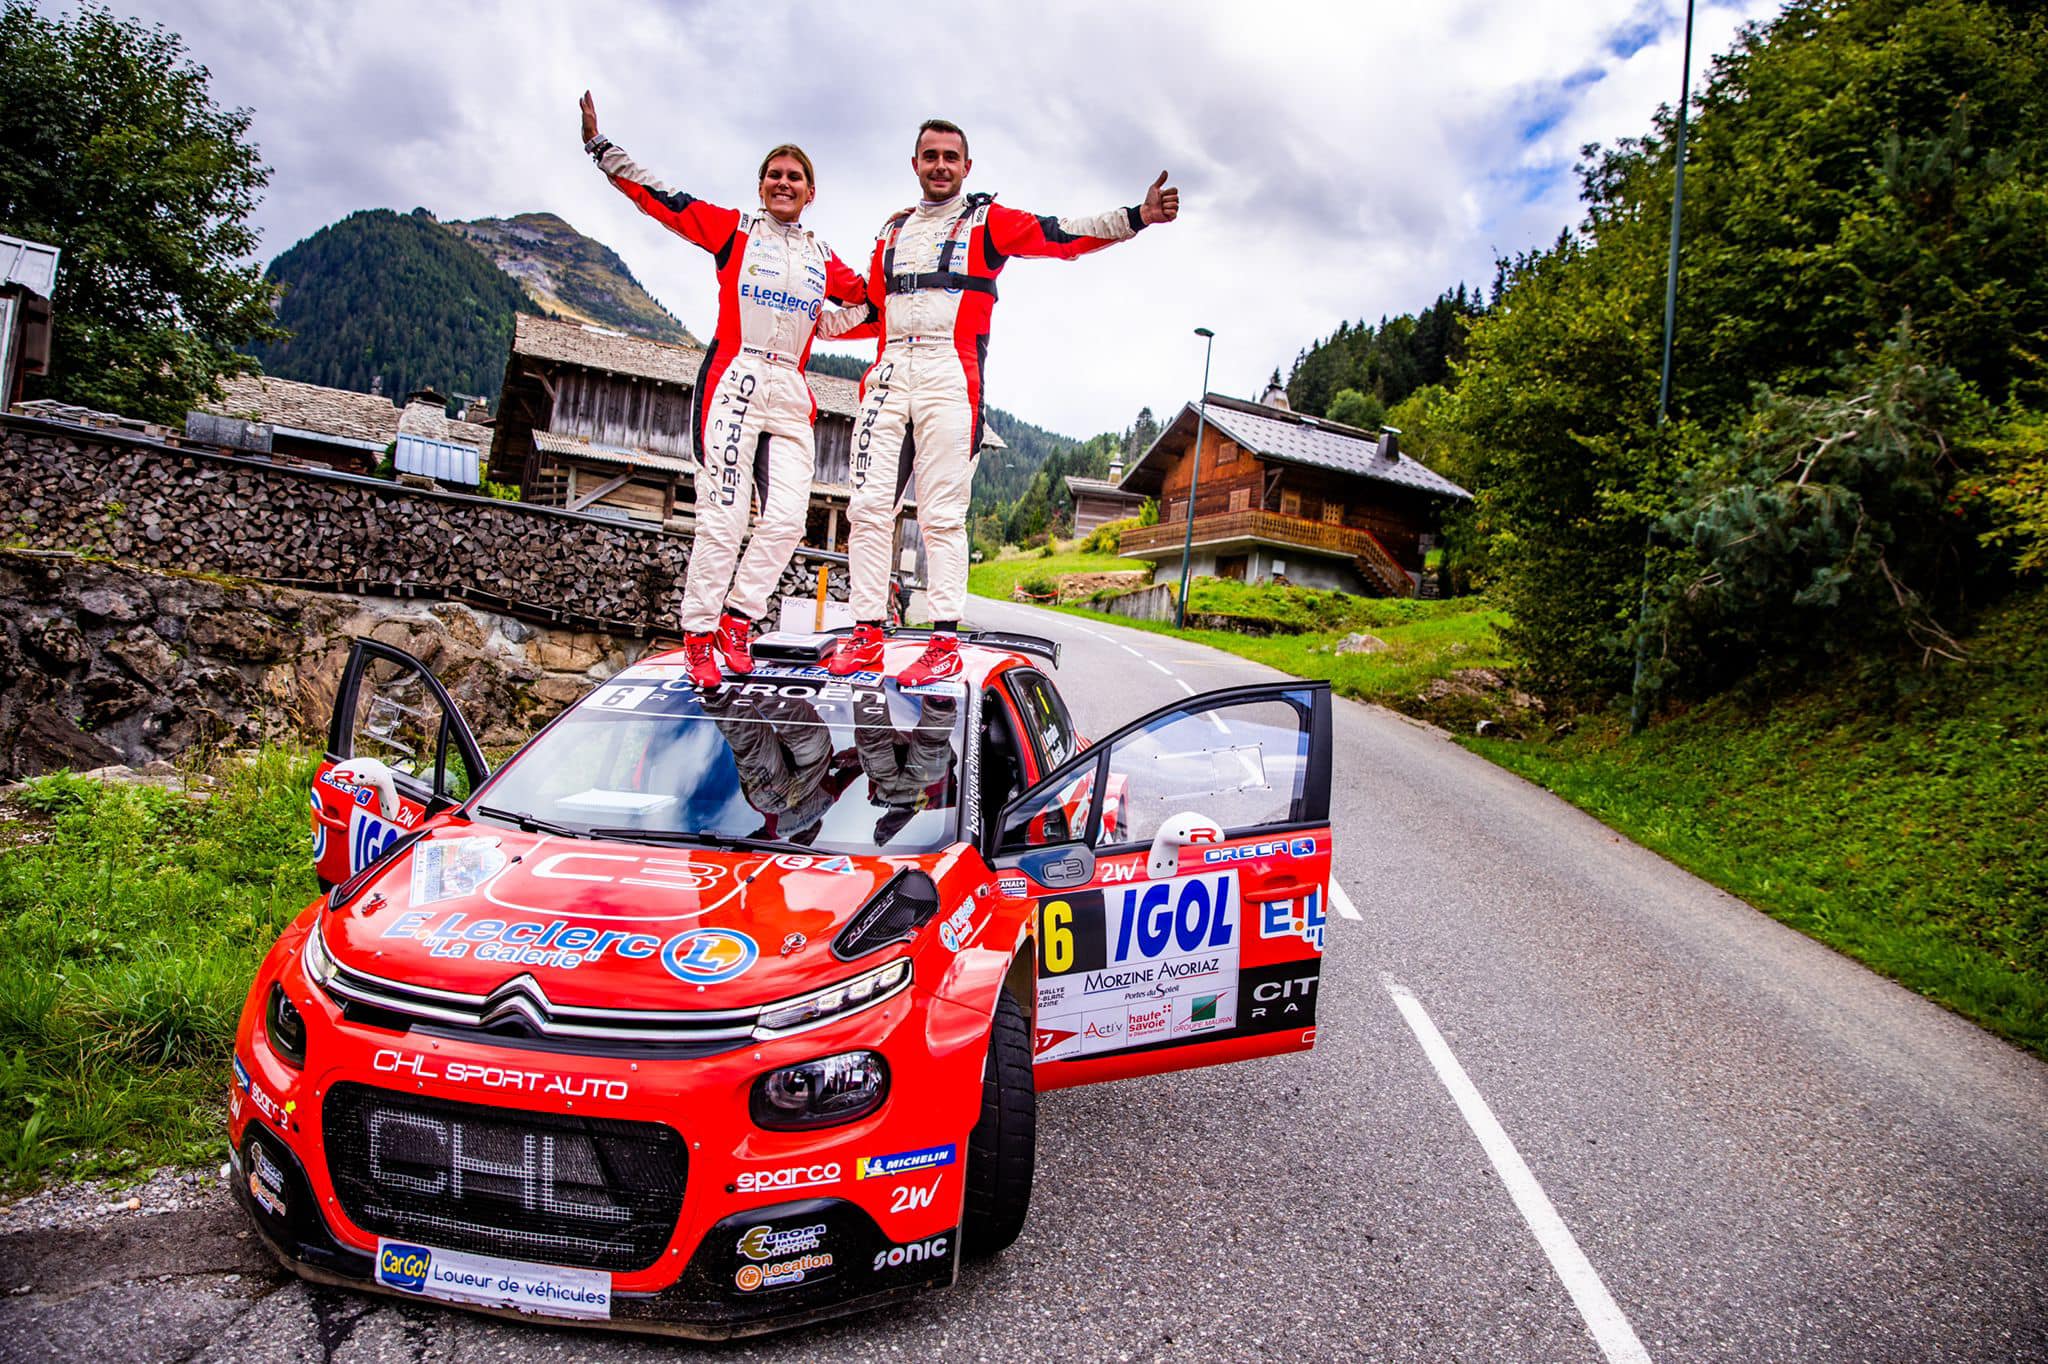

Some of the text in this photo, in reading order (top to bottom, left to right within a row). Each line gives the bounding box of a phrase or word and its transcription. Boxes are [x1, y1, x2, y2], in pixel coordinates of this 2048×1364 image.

[741, 284, 809, 311] E.Leclerc
[603, 687, 635, 706] 6
[1190, 827, 1216, 843] R
[1204, 841, 1288, 863] ORECA
[530, 852, 728, 891] C3
[1043, 858, 1085, 881] C3
[1114, 876, 1233, 962] IGOL
[381, 911, 661, 960] E.Leclerc
[1044, 900, 1075, 974] 6
[1084, 958, 1219, 992] MORZINE AVORIAZ
[1129, 1010, 1162, 1024] haute
[1129, 1019, 1166, 1032] savoie
[374, 1049, 628, 1100] CHL SPORT AUTO
[370, 1109, 634, 1222] CHL
[886, 1150, 949, 1169] MICHELIN
[737, 1162, 841, 1193] sparco
[890, 1173, 943, 1213] 2W
[381, 1248, 430, 1278] CarGo!
[762, 1253, 833, 1277] Location
[434, 1265, 607, 1305] Loueur de véhicules
